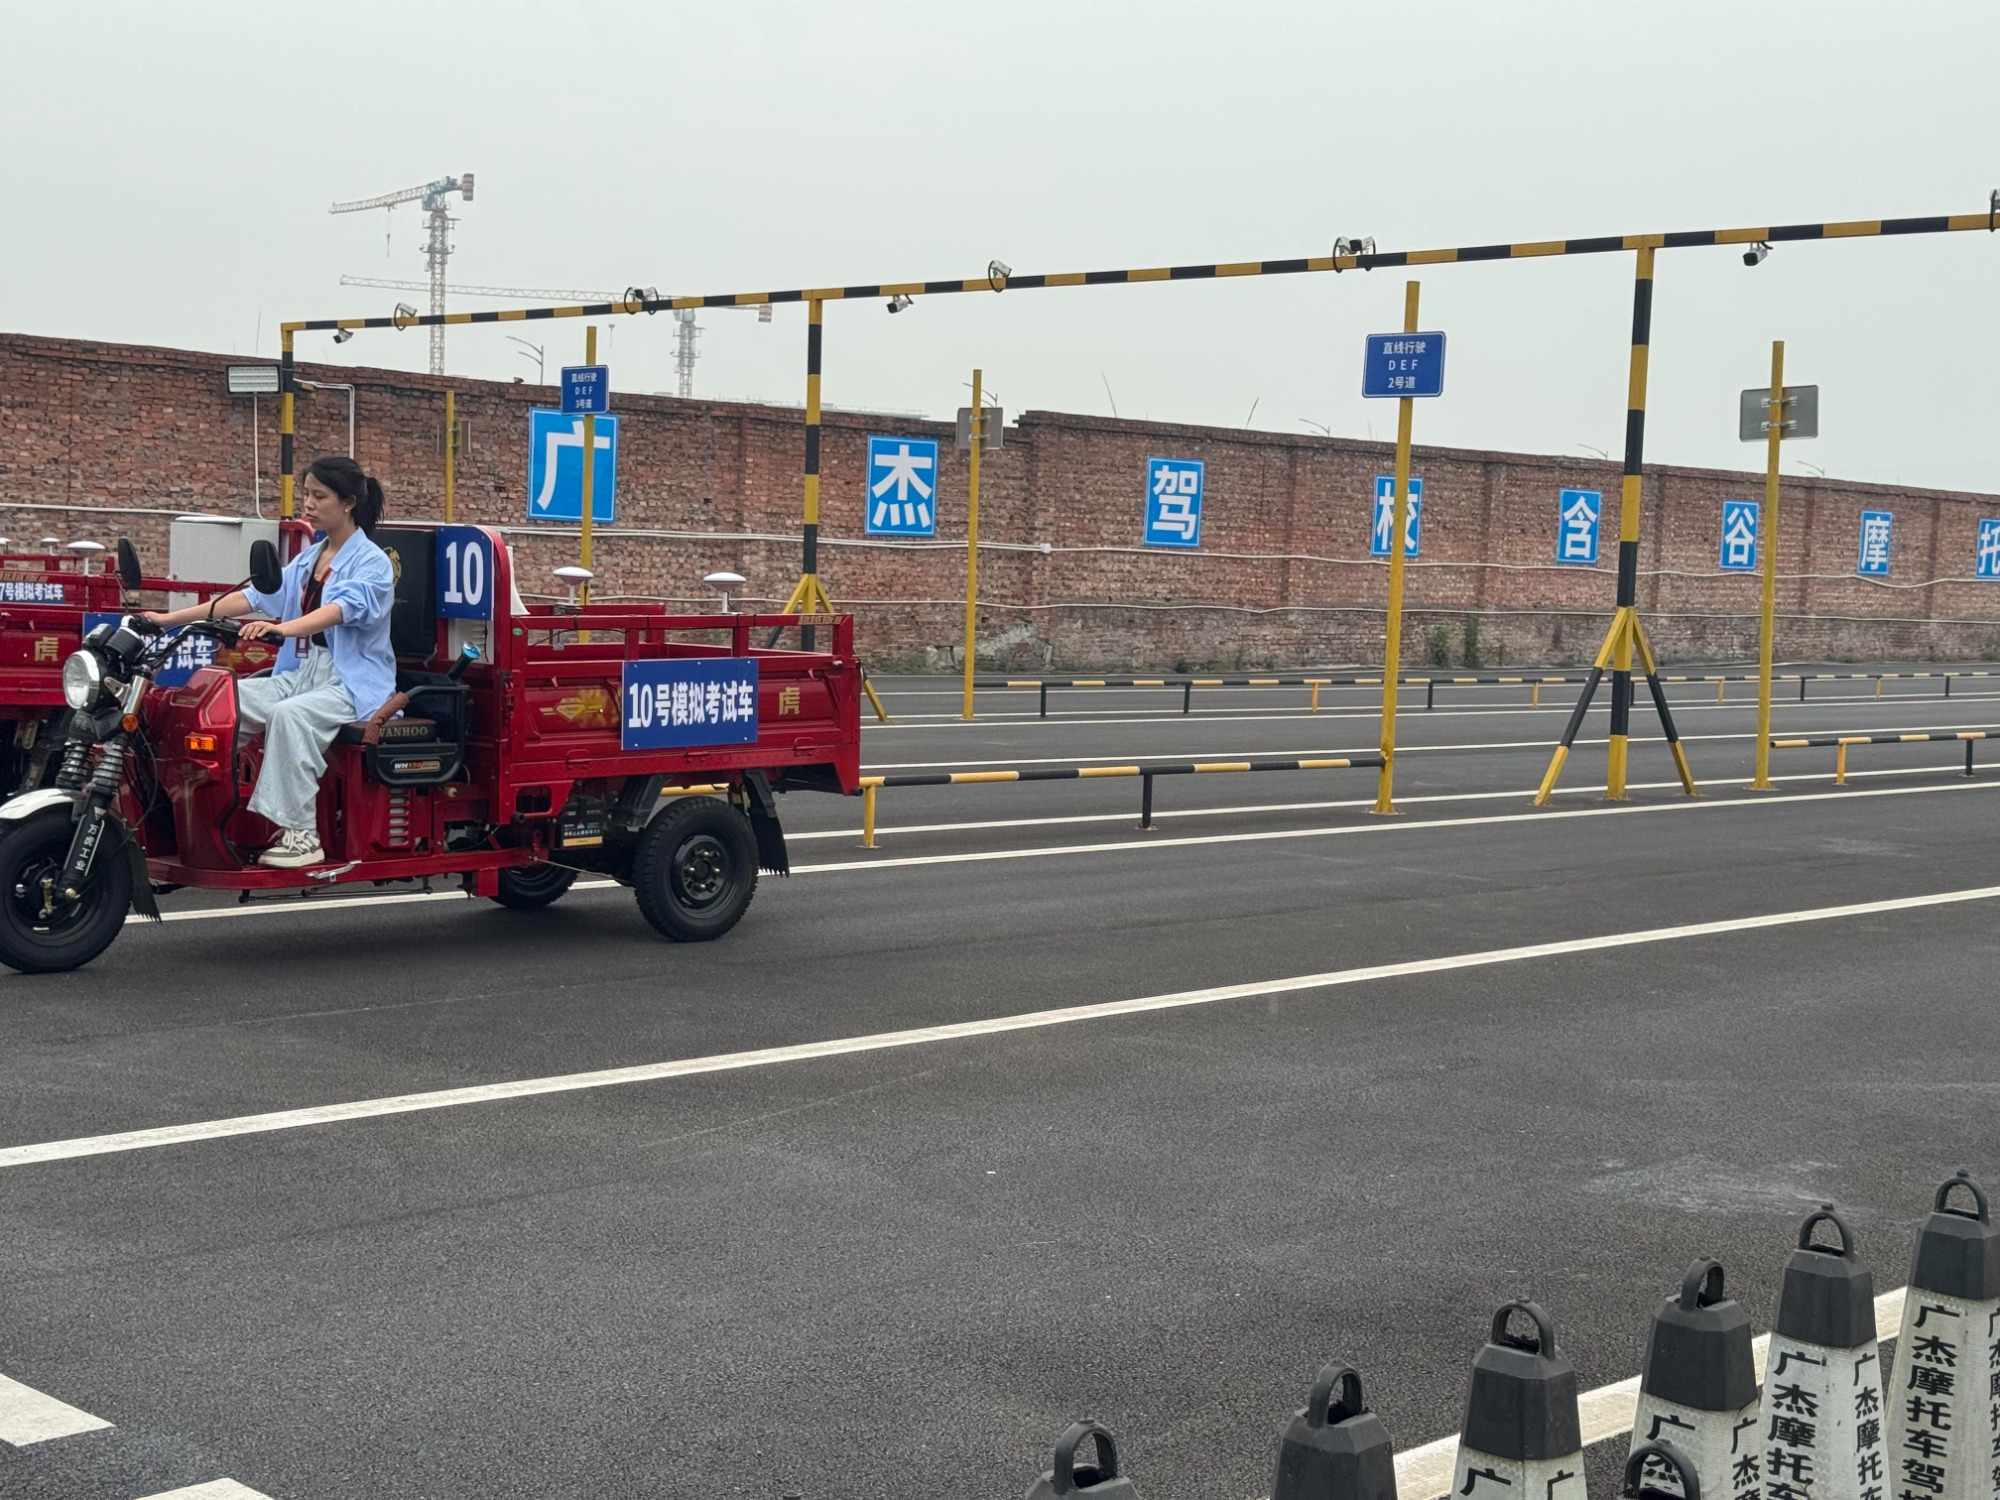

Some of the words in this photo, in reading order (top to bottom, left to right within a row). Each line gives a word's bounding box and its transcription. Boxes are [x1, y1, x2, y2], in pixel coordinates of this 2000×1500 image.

[1383, 341, 1426, 354] 直线行驶
[1388, 376, 1416, 389] 2号道
[536, 420, 611, 511] 广
[871, 445, 933, 528] 杰
[1152, 465, 1198, 540] 驾
[1377, 482, 1417, 550] 校
[1563, 496, 1597, 558] 含
[1725, 507, 1755, 564] 谷
[1861, 516, 1890, 570] 摩
[1979, 523, 2000, 574] 托
[444, 541, 484, 606] 10
[34, 637, 59, 662] 虎
[628, 680, 754, 728] 10号模拟考试车
[779, 687, 800, 716] 虎
